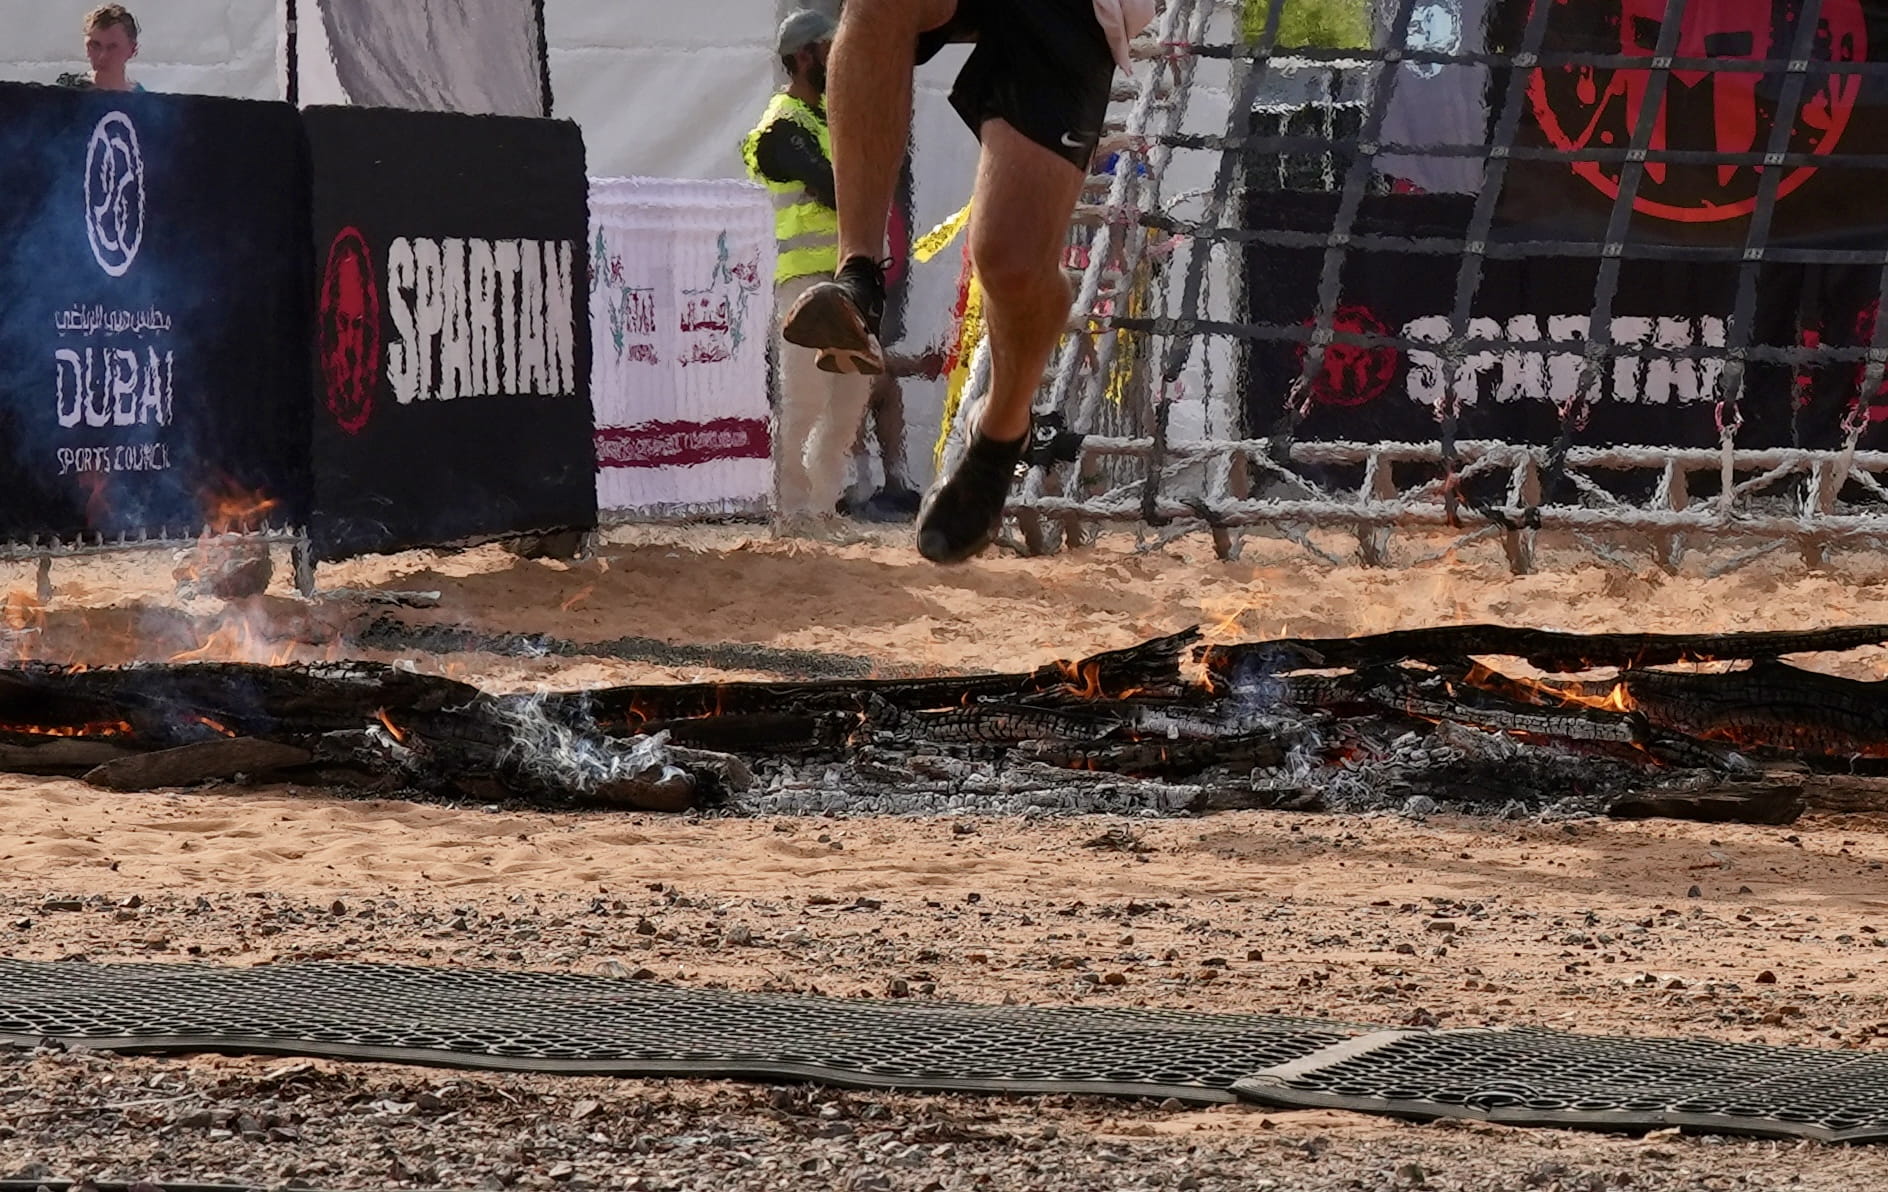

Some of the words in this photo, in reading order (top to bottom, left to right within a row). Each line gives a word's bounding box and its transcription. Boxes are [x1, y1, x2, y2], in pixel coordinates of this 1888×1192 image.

[386, 236, 576, 405] SPARTAN
[54, 345, 174, 428] DUBAI
[56, 446, 111, 476] SPORTS
